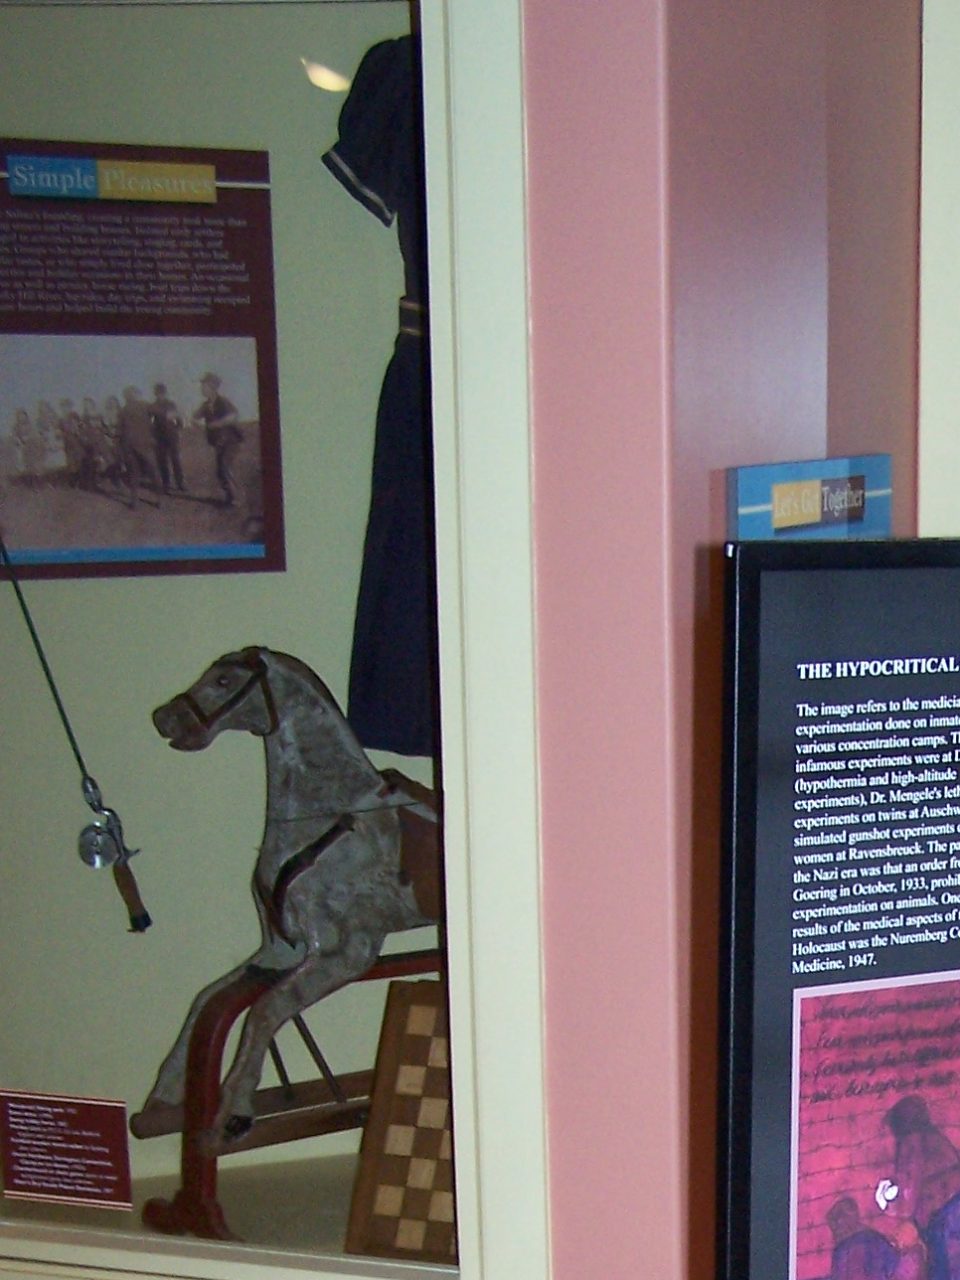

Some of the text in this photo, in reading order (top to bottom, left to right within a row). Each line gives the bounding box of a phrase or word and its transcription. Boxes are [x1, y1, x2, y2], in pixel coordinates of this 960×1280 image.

[14, 164, 216, 194] Simple Pleasures
[822, 483, 864, 517] Together
[797, 663, 832, 679] THE
[836, 657, 959, 677] HYPOCRITICAL
[796, 704, 818, 716] The
[821, 703, 854, 717] image
[856, 700, 887, 713] refers
[889, 701, 900, 711] to
[902, 698, 919, 710] the
[796, 719, 882, 738] experimentation
[885, 717, 911, 730] done
[913, 719, 927, 728] on
[796, 740, 836, 754] various
[838, 735, 909, 751] concentration
[912, 736, 948, 748] camps.
[796, 759, 846, 772] infamous
[848, 755, 912, 771] experiments
[914, 754, 940, 764] were
[942, 752, 952, 762] at
[795, 768, 957, 794] (hypothermia and high-altitude
[870, 792, 886, 804] Dr.
[889, 787, 942, 804] Mengele's
[794, 813, 860, 830] experiments
[862, 813, 876, 822] on
[878, 808, 907, 821] twins
[909, 808, 919, 819] at
[794, 830, 846, 846] simulated
[849, 828, 890, 845] gunshot
[892, 823, 955, 840] experiments
[794, 853, 833, 864] women
[836, 850, 846, 861] at
[928, 840, 947, 853] The
[794, 870, 811, 883] the
[813, 867, 838, 881] Nazi
[841, 869, 857, 879] era
[860, 867, 881, 876] was
[883, 862, 903, 874] that
[905, 863, 918, 873] an
[920, 858, 948, 871] order
[793, 886, 837, 901] Goering
[840, 885, 850, 896] in
[901, 877, 929, 891] 1933,
[793, 900, 878, 922] experimentation
[880, 901, 894, 910] on
[896, 894, 938, 909] animals.
[793, 923, 827, 937] results
[830, 920, 842, 933] of
[842, 920, 861, 932] the
[863, 914, 904, 930] medical
[906, 913, 943, 928] aspects
[945, 909, 956, 921] of
[793, 940, 846, 955] Holocaust
[848, 939, 869, 949] was
[871, 934, 888, 947] the
[890, 930, 947, 945] Nuremberg
[849, 953, 877, 967] 1947.
